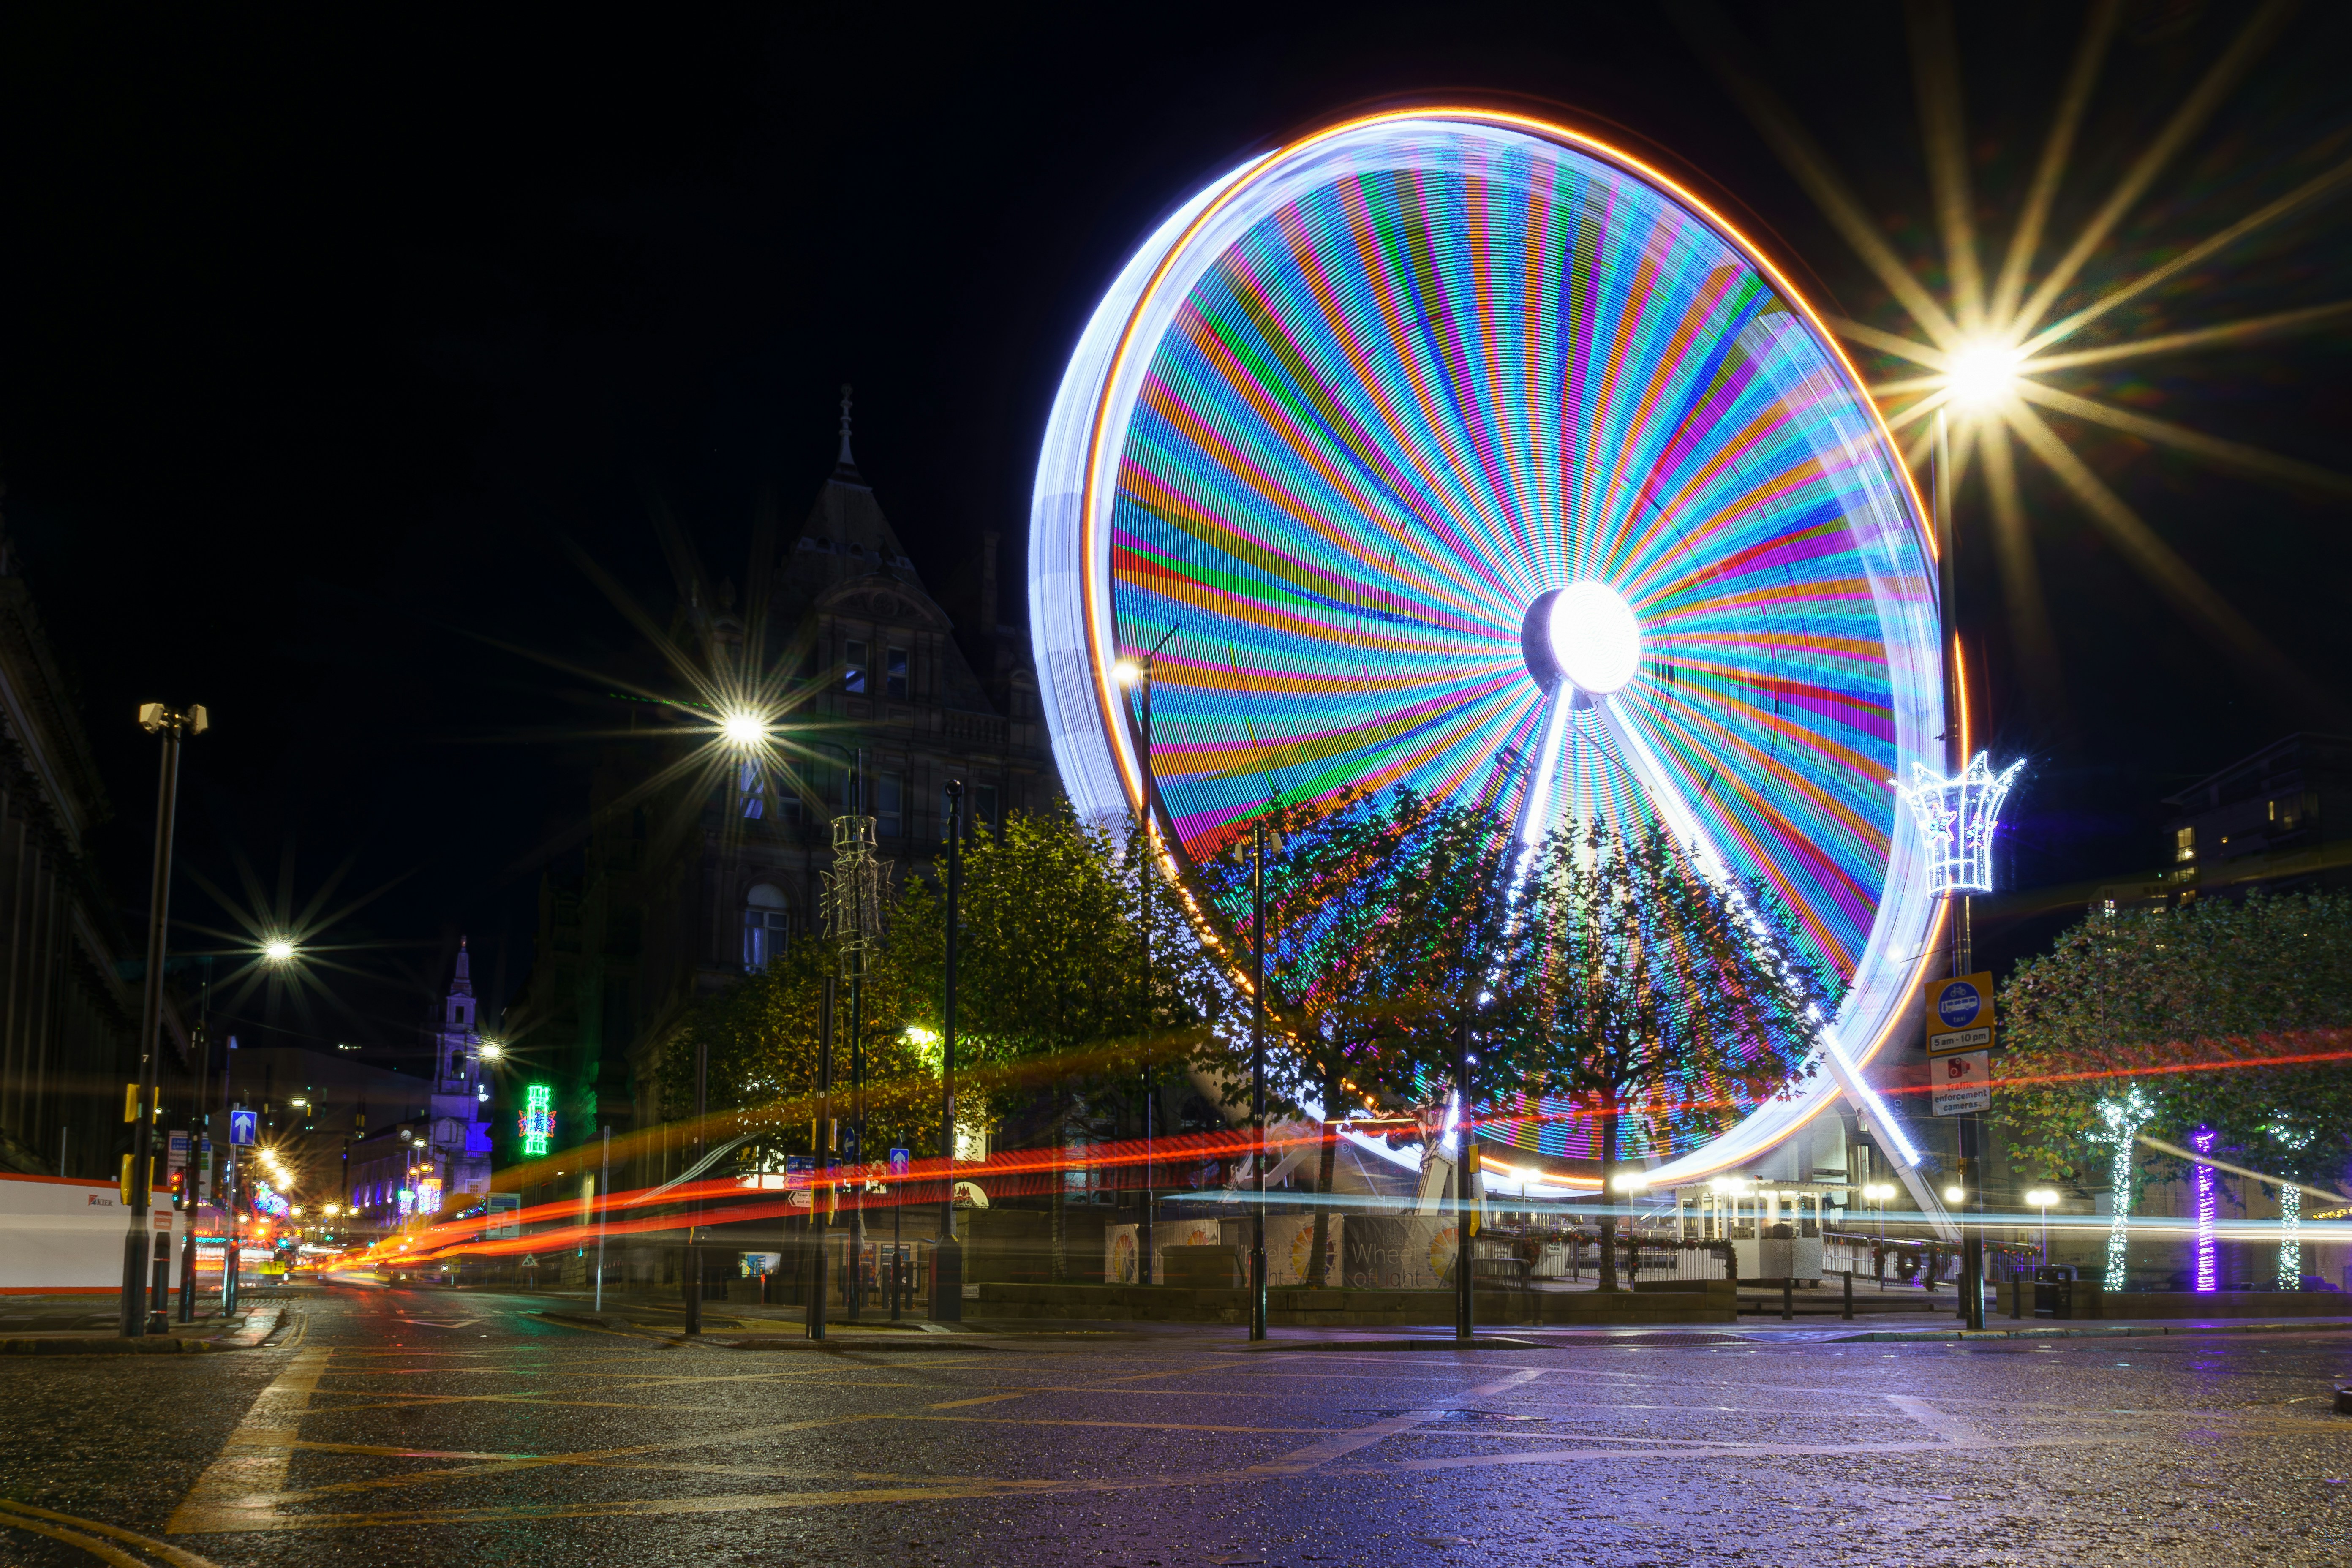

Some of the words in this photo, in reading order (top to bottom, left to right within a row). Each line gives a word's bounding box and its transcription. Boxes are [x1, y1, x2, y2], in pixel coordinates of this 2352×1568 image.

[1953, 1015, 1966, 1023] taxi
[1934, 1038, 1940, 1047] 5
[1961, 1033, 1971, 1043] 10
[1972, 1033, 1986, 1042] pm
[142, 1054, 150, 1063] 7
[1946, 1081, 1974, 1091] Traffic
[1935, 1089, 1987, 1102] enforcement
[1944, 1101, 1978, 1111] cameras
[1382, 1236, 1409, 1246] Leeds
[1352, 1243, 1417, 1265] Wheel
[1354, 1268, 1374, 1287] of
[1376, 1268, 1421, 1289] Light
